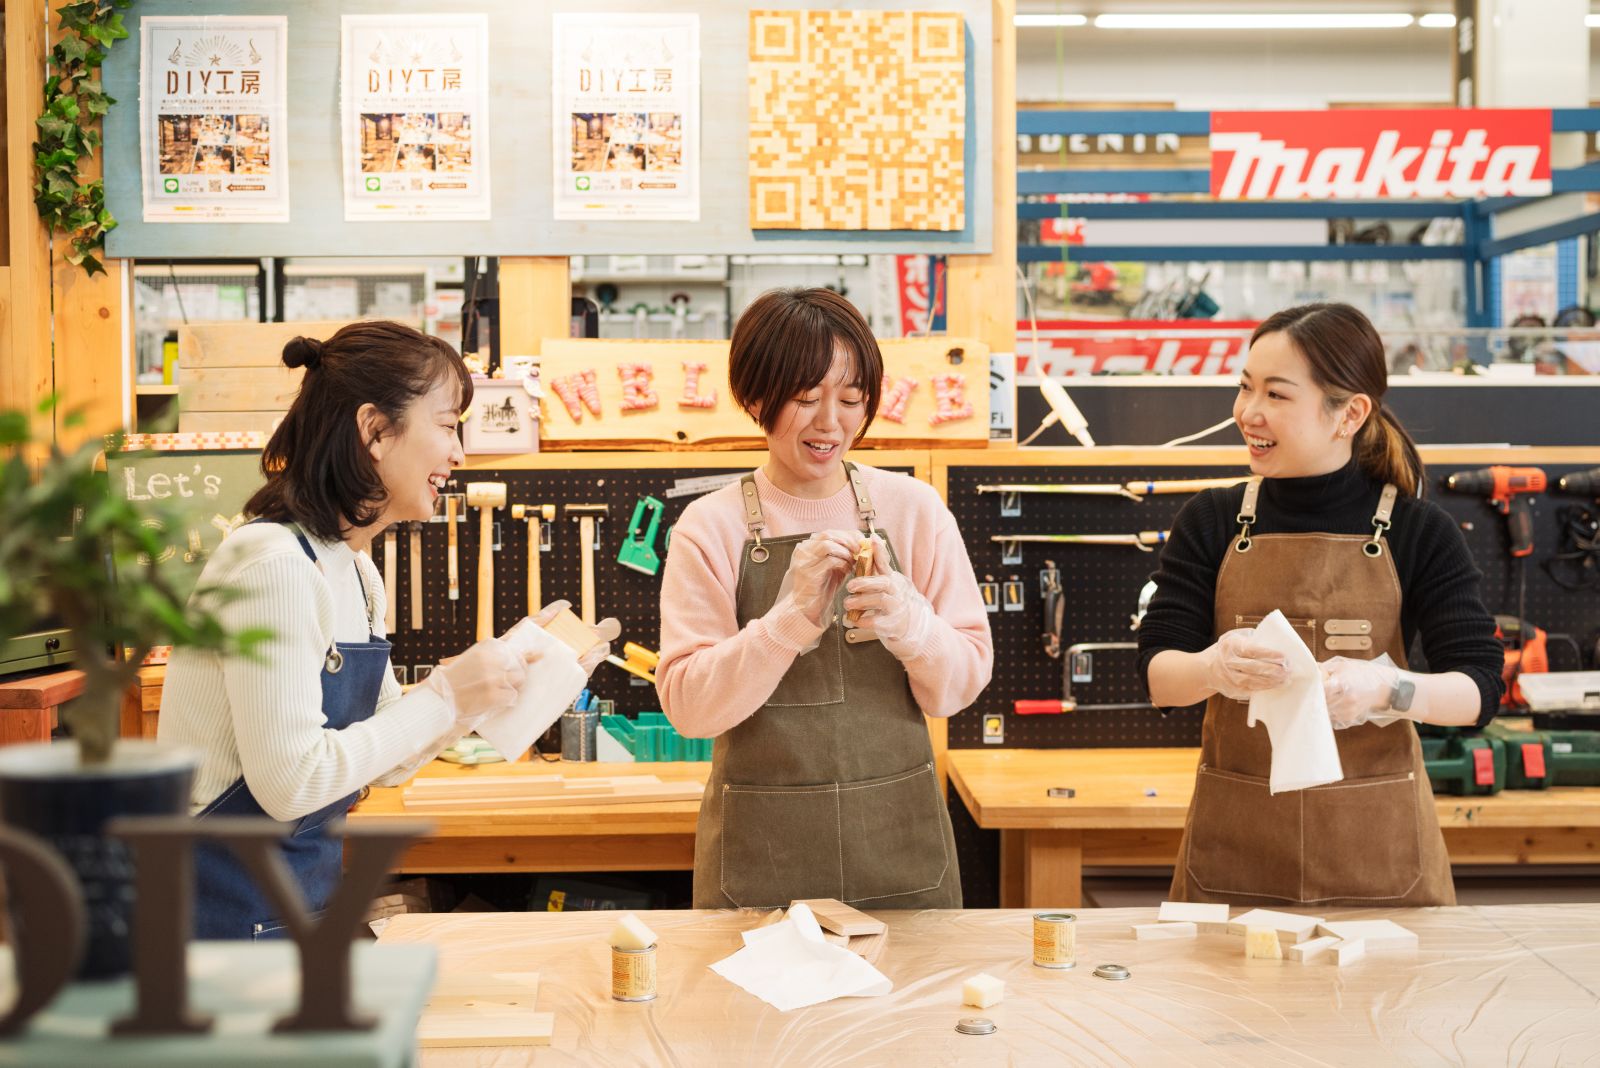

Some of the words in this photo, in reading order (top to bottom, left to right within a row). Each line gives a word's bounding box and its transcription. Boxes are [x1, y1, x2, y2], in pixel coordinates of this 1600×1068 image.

[167, 70, 260, 94] DIY工房
[580, 68, 673, 92] DIY工房
[1210, 129, 1552, 200] makita
[123, 463, 222, 501] Let's
